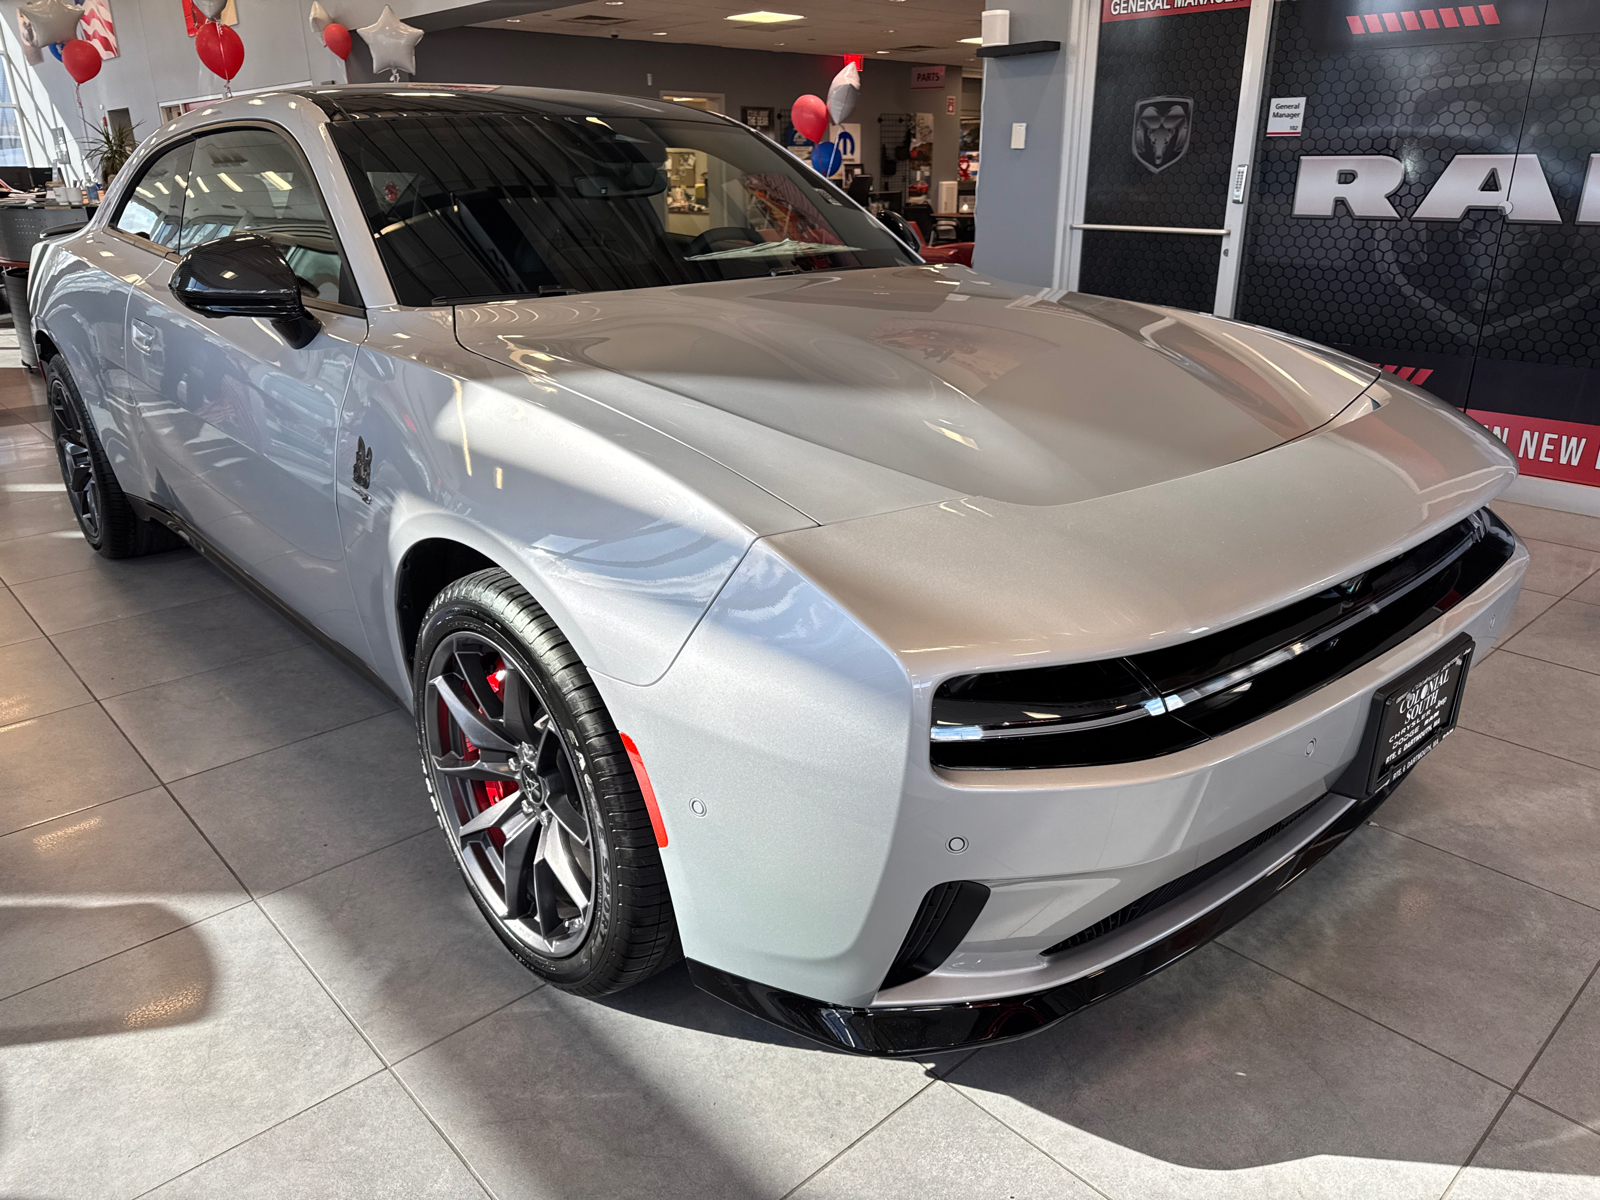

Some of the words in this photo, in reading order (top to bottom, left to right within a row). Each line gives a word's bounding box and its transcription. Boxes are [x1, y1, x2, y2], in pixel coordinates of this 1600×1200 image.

[916, 73, 940, 82] PARTS
[1272, 112, 1301, 120] Manager
[1292, 153, 1600, 225] RA
[1518, 429, 1587, 467] NEW
[1399, 668, 1450, 714] COLONIAL
[1404, 688, 1440, 724] SOUTH
[1388, 709, 1432, 743] CHRYSLER
[1435, 696, 1448, 709] Jeep
[1391, 725, 1421, 750] DODGE
[1423, 710, 1440, 726] RAM
[599, 855, 612, 946] SPORT
